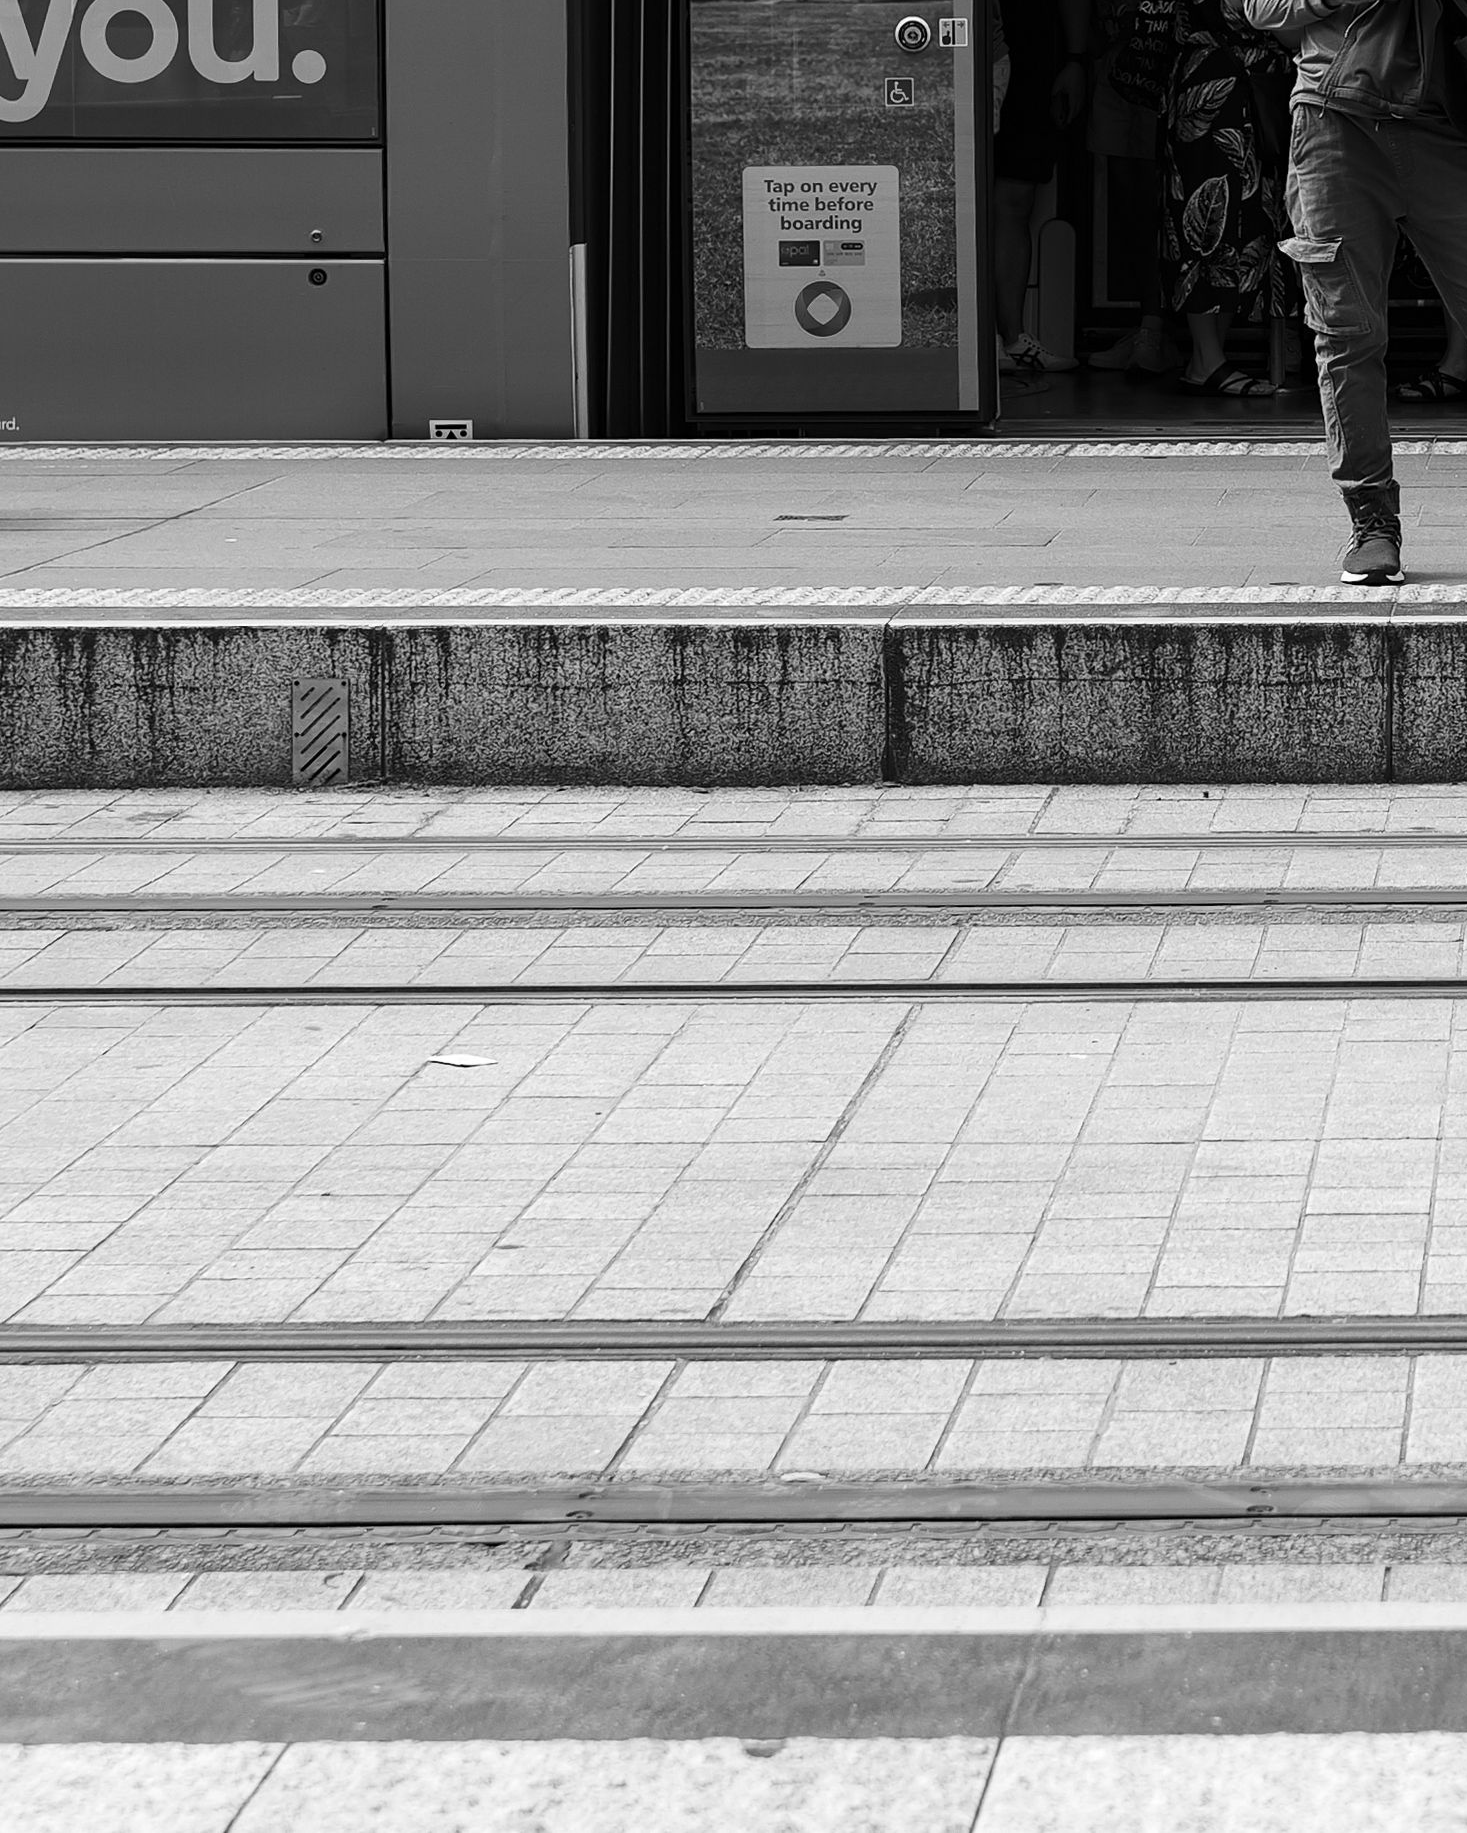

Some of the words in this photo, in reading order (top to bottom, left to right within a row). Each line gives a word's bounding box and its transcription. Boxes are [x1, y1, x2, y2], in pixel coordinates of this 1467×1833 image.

[764, 179, 795, 196] Tap
[800, 181, 823, 193] on
[829, 181, 877, 195] every
[768, 197, 809, 212] time
[815, 197, 874, 212] before
[781, 215, 862, 233] boarding
